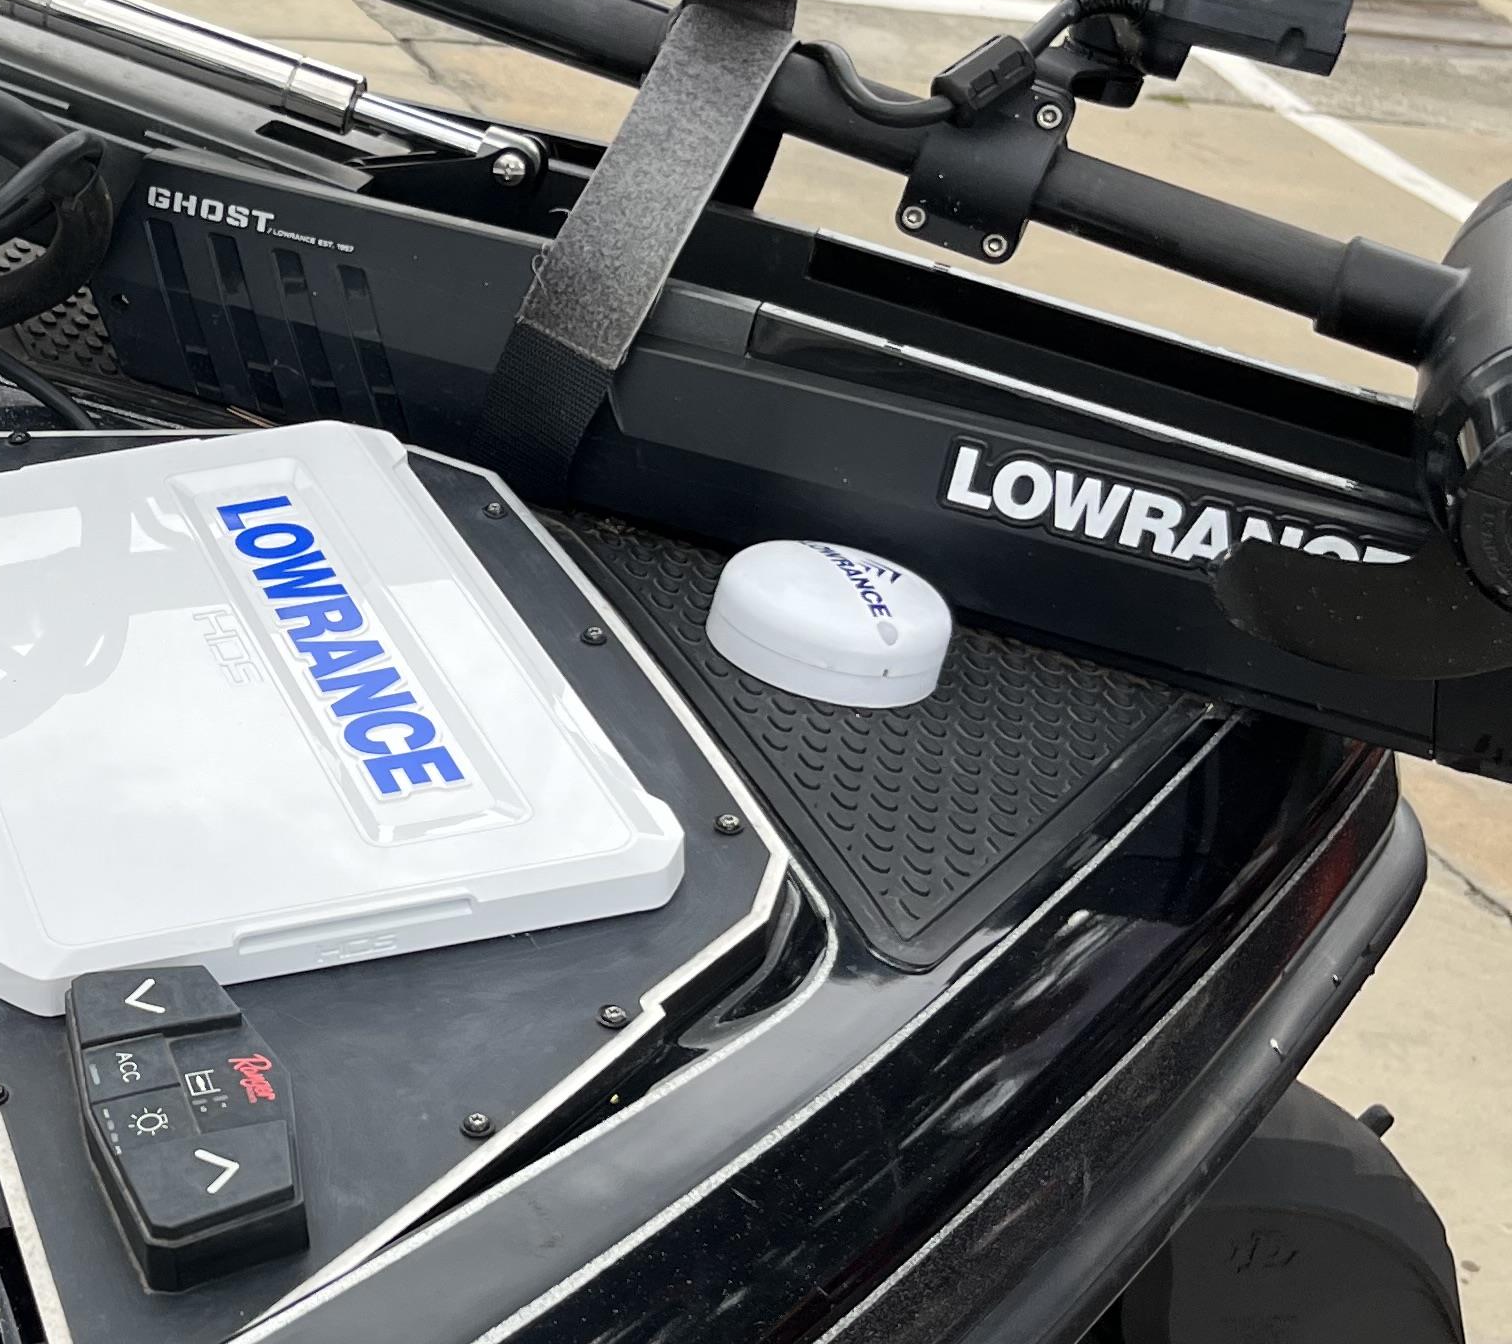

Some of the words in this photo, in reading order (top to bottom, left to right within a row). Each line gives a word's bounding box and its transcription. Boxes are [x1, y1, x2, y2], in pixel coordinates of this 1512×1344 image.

[147, 185, 275, 233] GHOST
[946, 445, 1414, 564] LOWRA
[799, 540, 893, 618] LOWRANCE
[192, 609, 265, 687] HDS
[216, 495, 466, 797] LOWRANCE
[115, 1052, 141, 1083] ACC
[228, 1053, 276, 1101] Ranger
